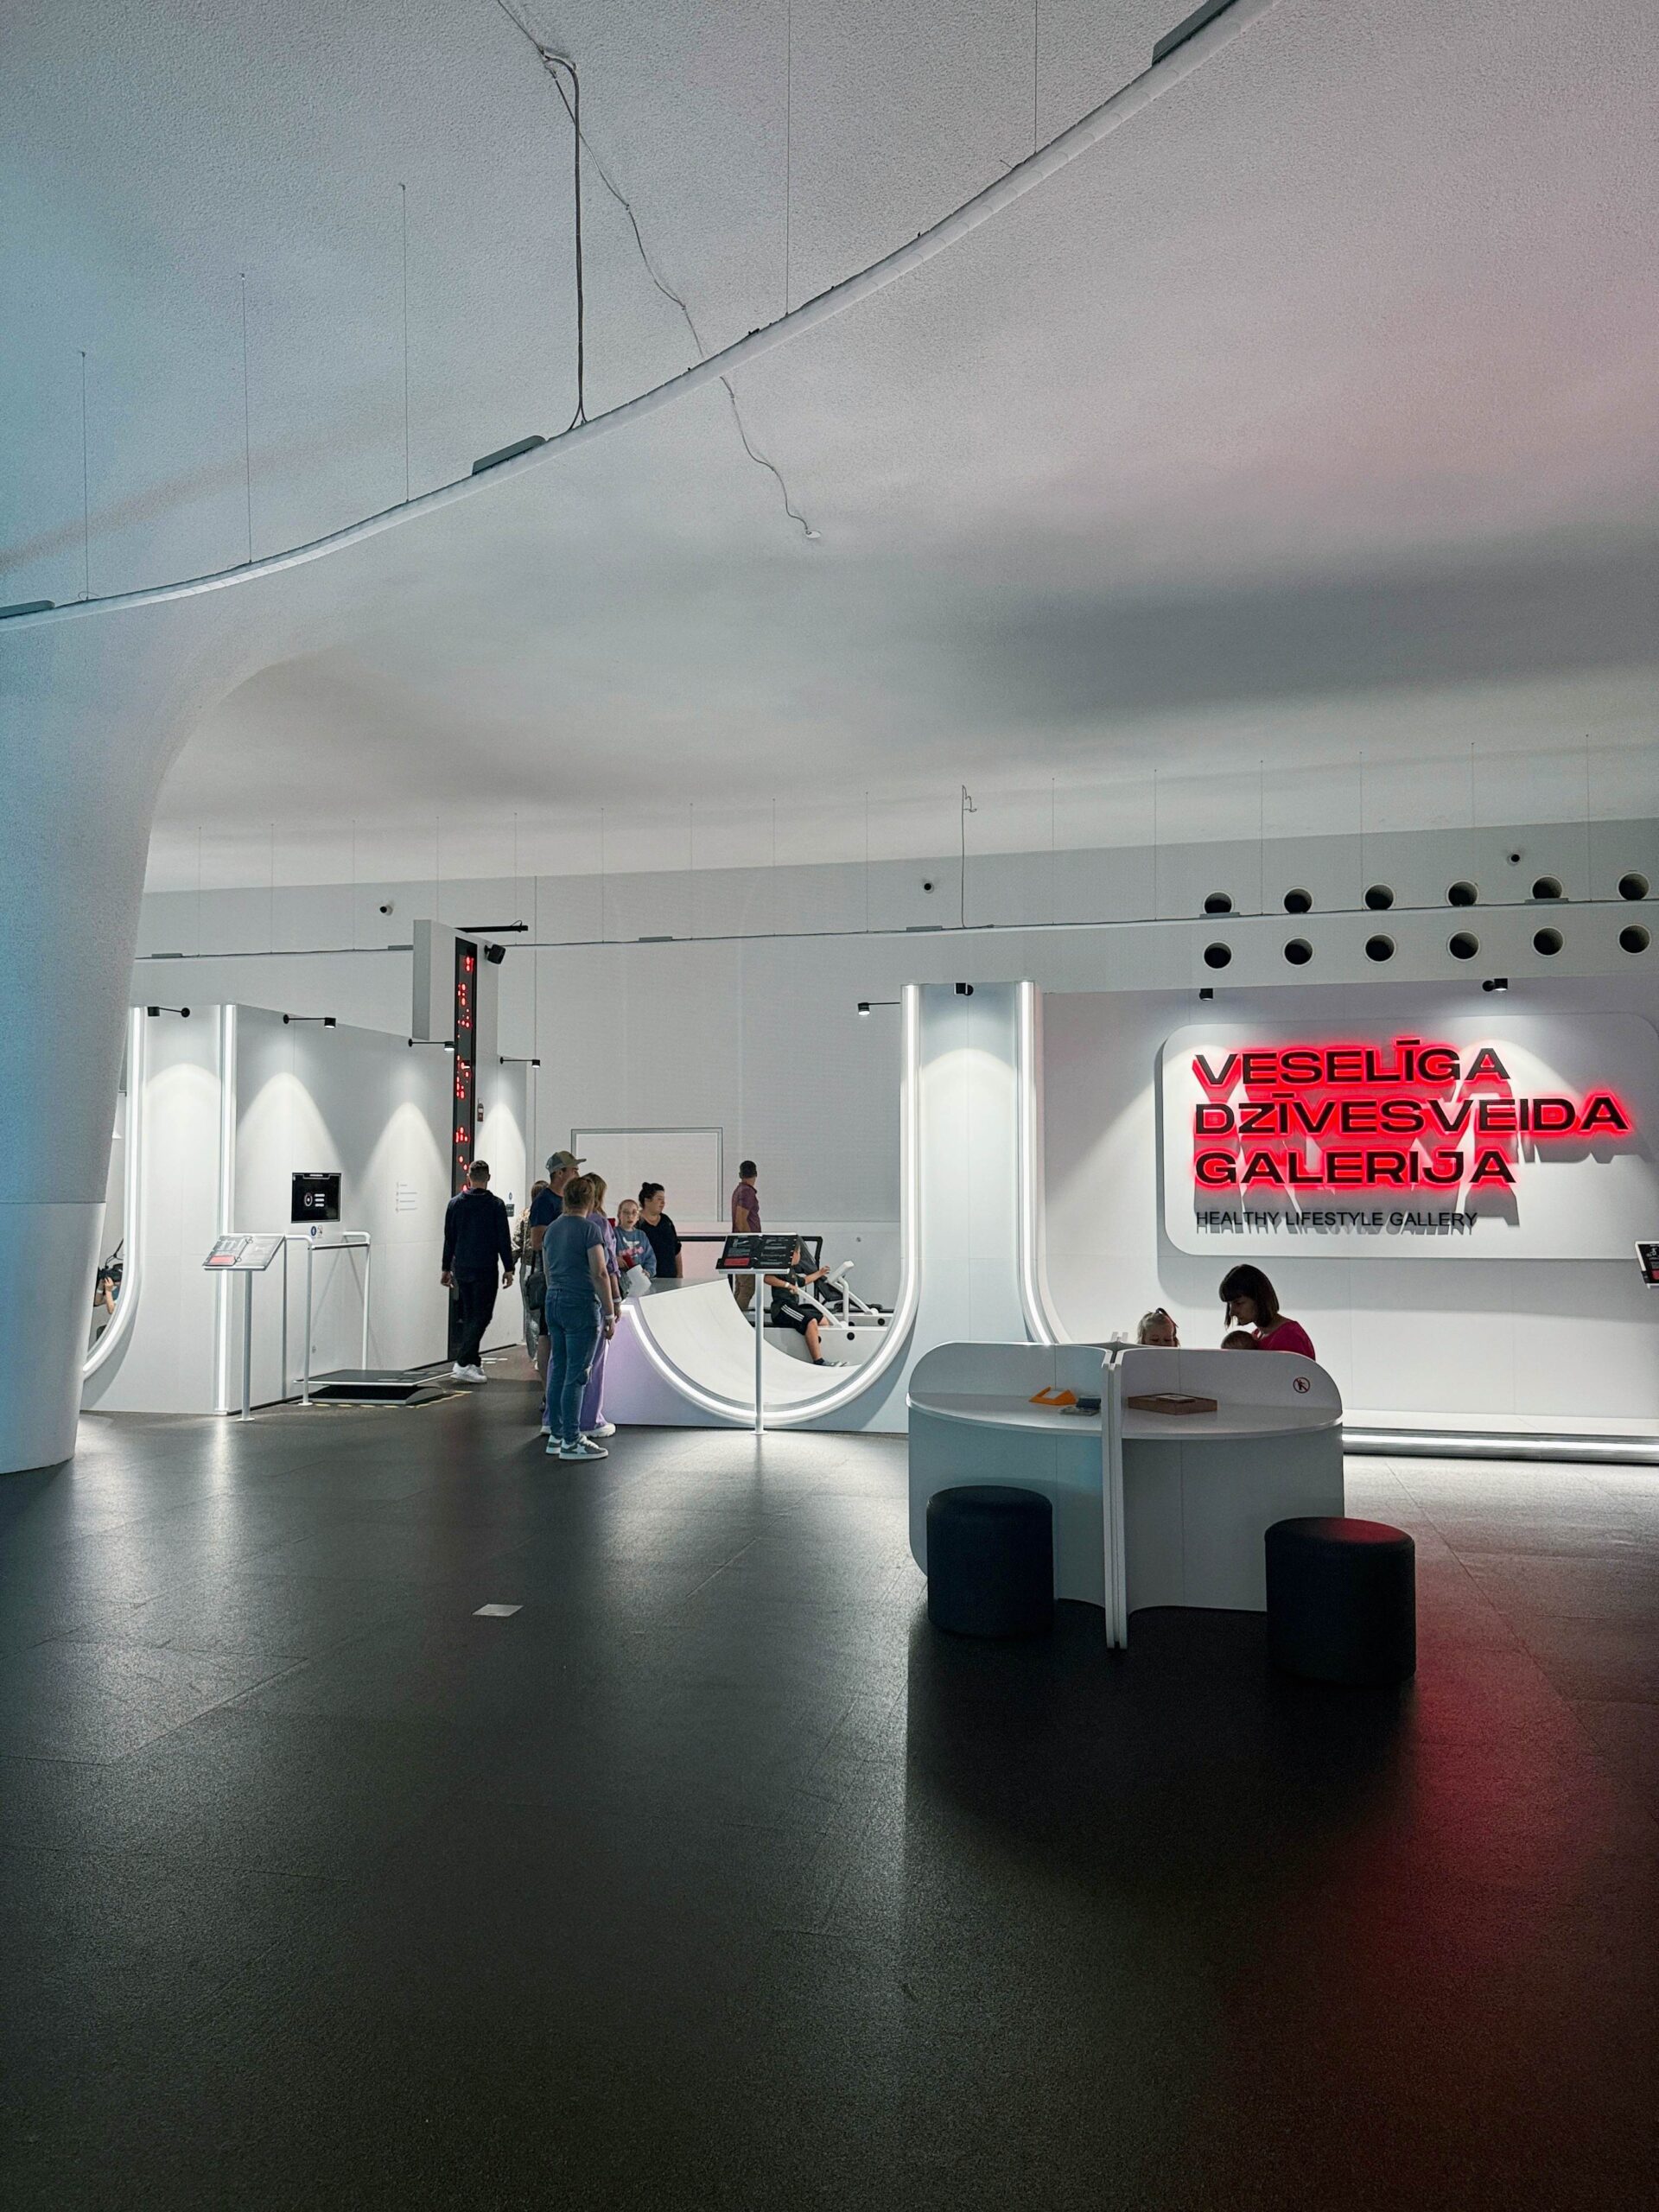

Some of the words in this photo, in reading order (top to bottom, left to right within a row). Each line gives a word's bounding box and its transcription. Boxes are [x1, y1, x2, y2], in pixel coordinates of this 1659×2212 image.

[1194, 1039, 1511, 1085] VESELĪGA
[1195, 1093, 1630, 1135] DZĪVESVEIDA
[1195, 1150, 1517, 1185] GALERIJA
[1196, 1211, 1281, 1226] HEALTHY
[1285, 1211, 1383, 1226] LIFESTYLE
[1389, 1211, 1478, 1227] GALLERY
